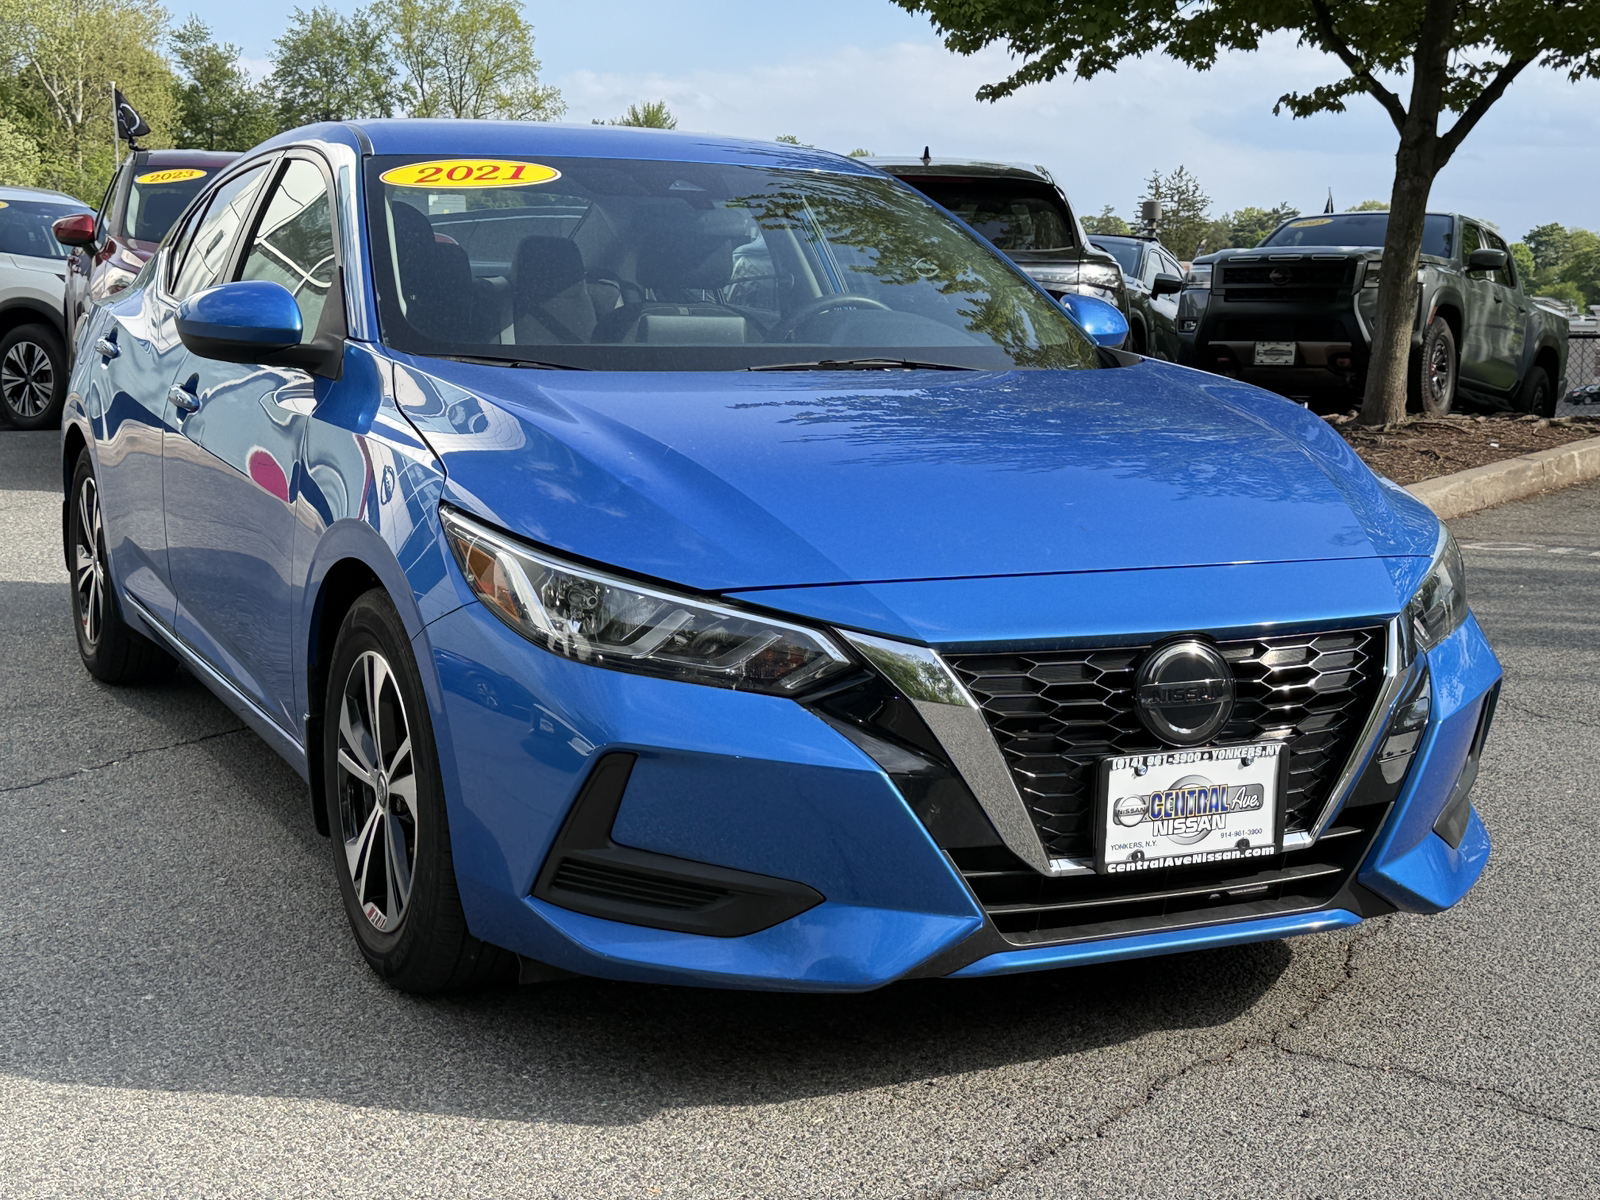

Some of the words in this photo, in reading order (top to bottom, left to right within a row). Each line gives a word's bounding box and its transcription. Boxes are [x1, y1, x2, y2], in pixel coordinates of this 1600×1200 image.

[150, 170, 194, 182] 2023
[414, 165, 526, 183] 2021
[1151, 684, 1223, 702] NISSAN
[1149, 784, 1230, 820] CENTRAL
[1231, 786, 1260, 810] Ave.
[1118, 807, 1146, 816] NISSAN
[1153, 814, 1226, 837] NISSAN
